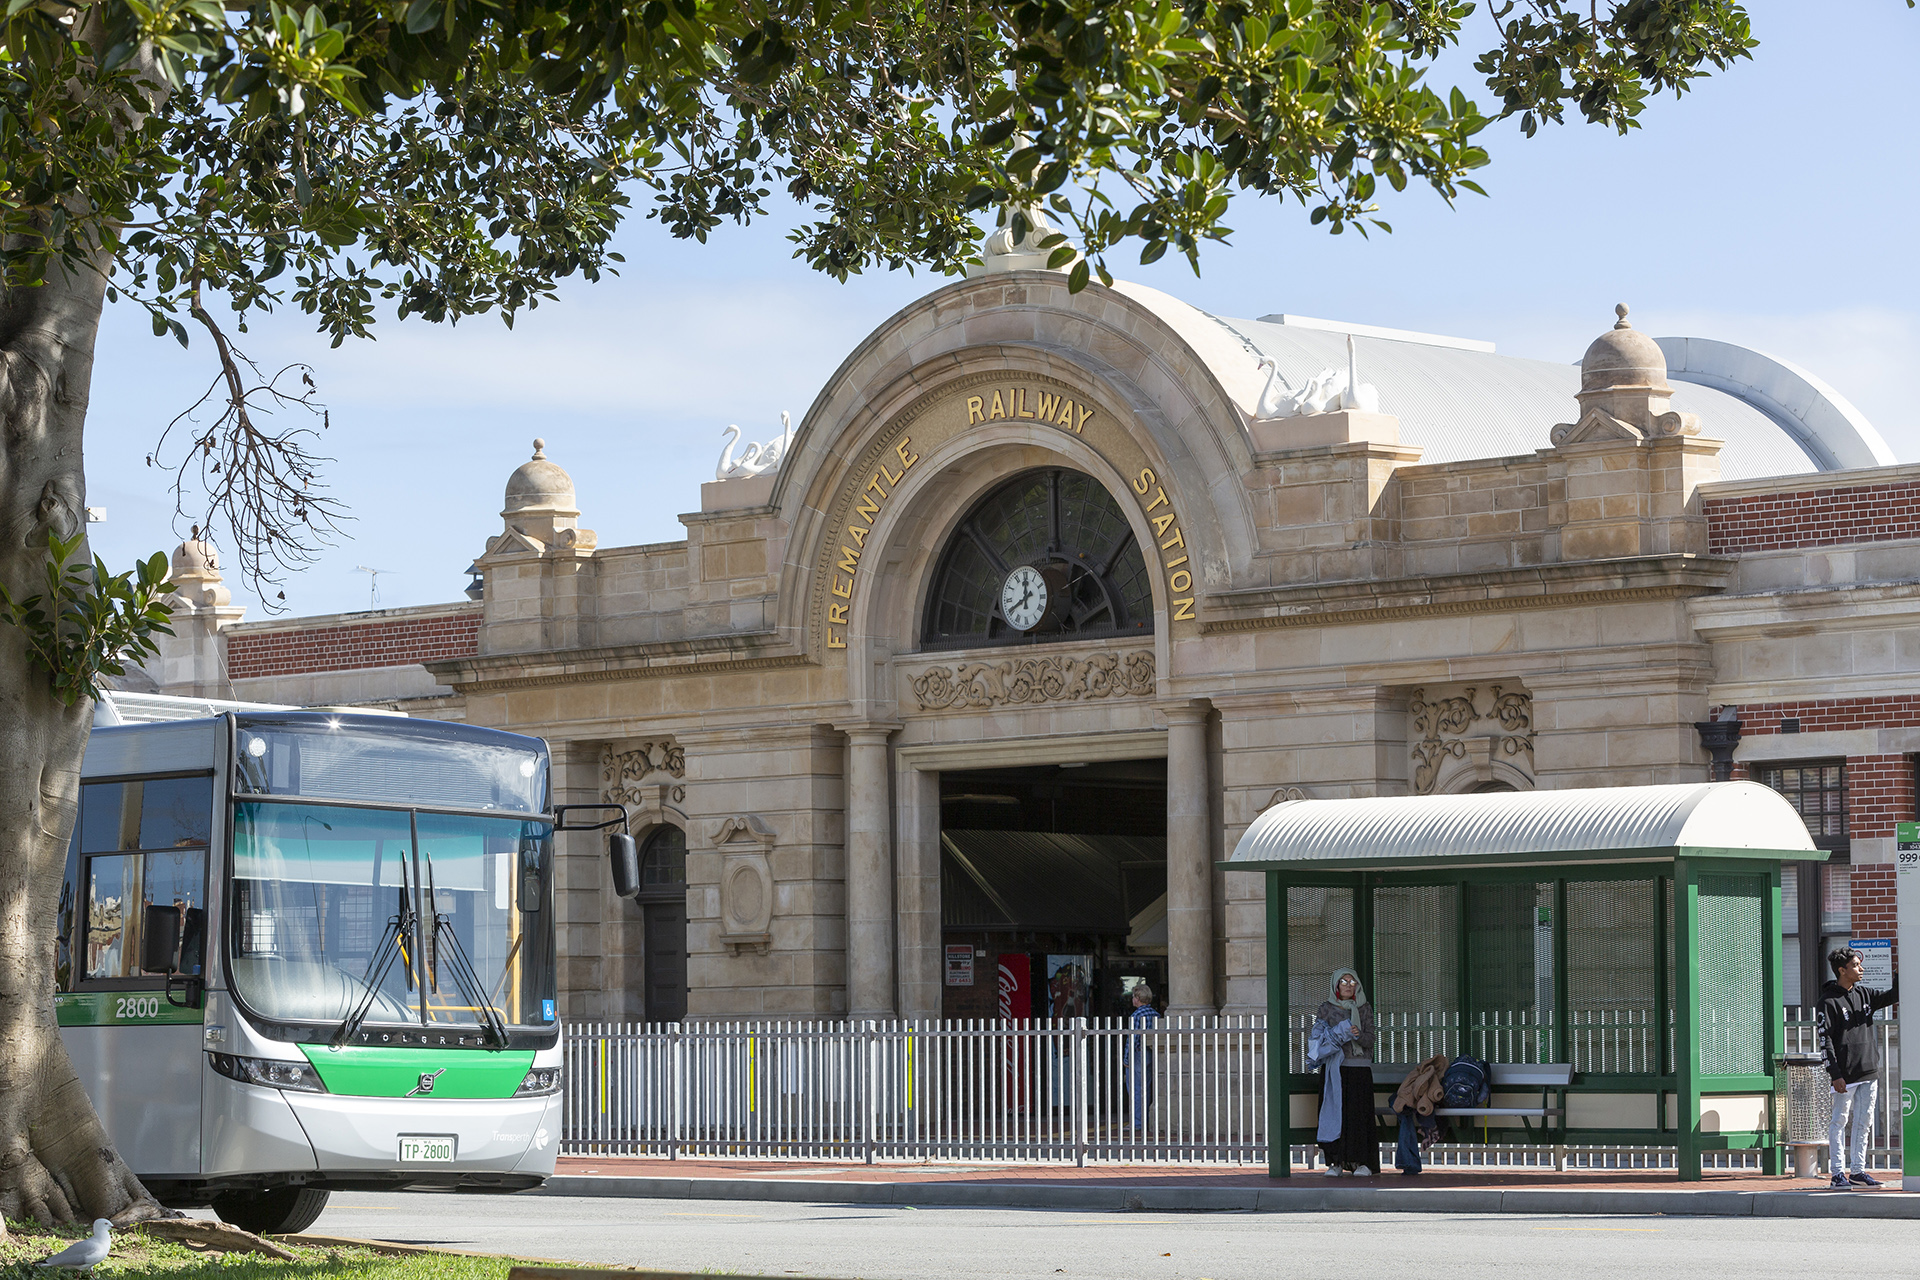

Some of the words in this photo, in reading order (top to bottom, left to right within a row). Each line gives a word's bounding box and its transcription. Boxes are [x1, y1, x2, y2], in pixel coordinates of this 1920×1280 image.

[827, 436, 920, 650] FREMANTLE
[967, 388, 1096, 434] RAILWAY
[1133, 467, 1197, 622] STATION
[1899, 853, 1918, 862] 999
[115, 997, 159, 1018] 2800
[362, 1033, 483, 1046] VOLGREN
[492, 1131, 530, 1144] Transperth
